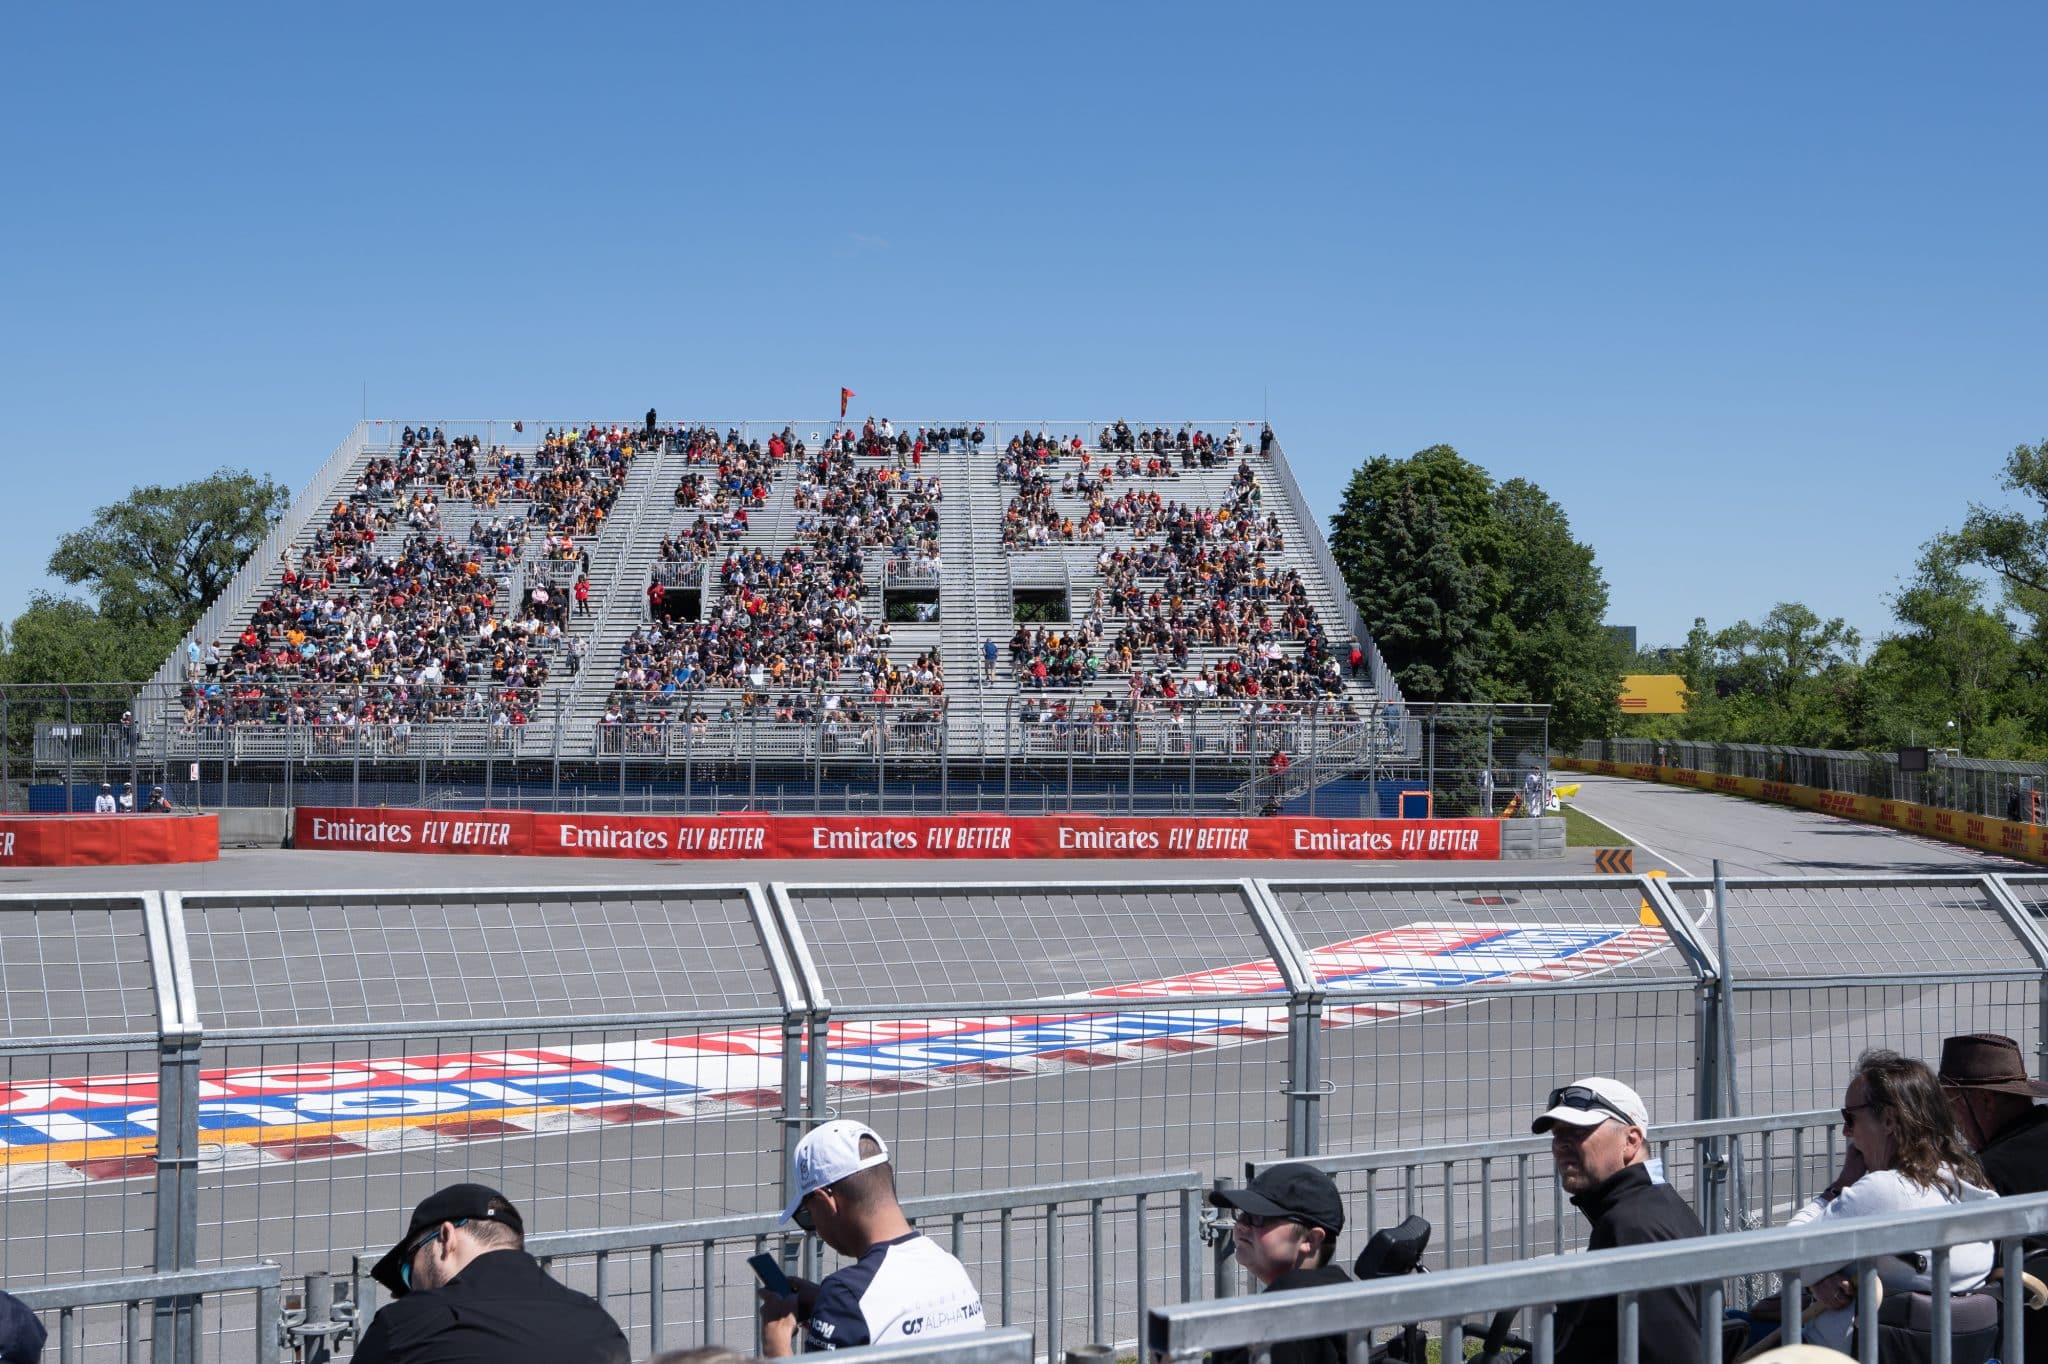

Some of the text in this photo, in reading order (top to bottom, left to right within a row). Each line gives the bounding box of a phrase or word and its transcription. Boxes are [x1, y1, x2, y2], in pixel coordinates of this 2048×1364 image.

[812, 432, 819, 440] 2
[1819, 792, 1857, 813] DHL
[313, 818, 511, 845] Emirates FLY BETTER
[559, 825, 765, 849] Emirates FLY BETTER
[813, 827, 1012, 849] Emirates FLY BETTER
[1058, 827, 1249, 850] Emirates FLY BETTER
[1295, 829, 1479, 850] Emirates FLY BETTER
